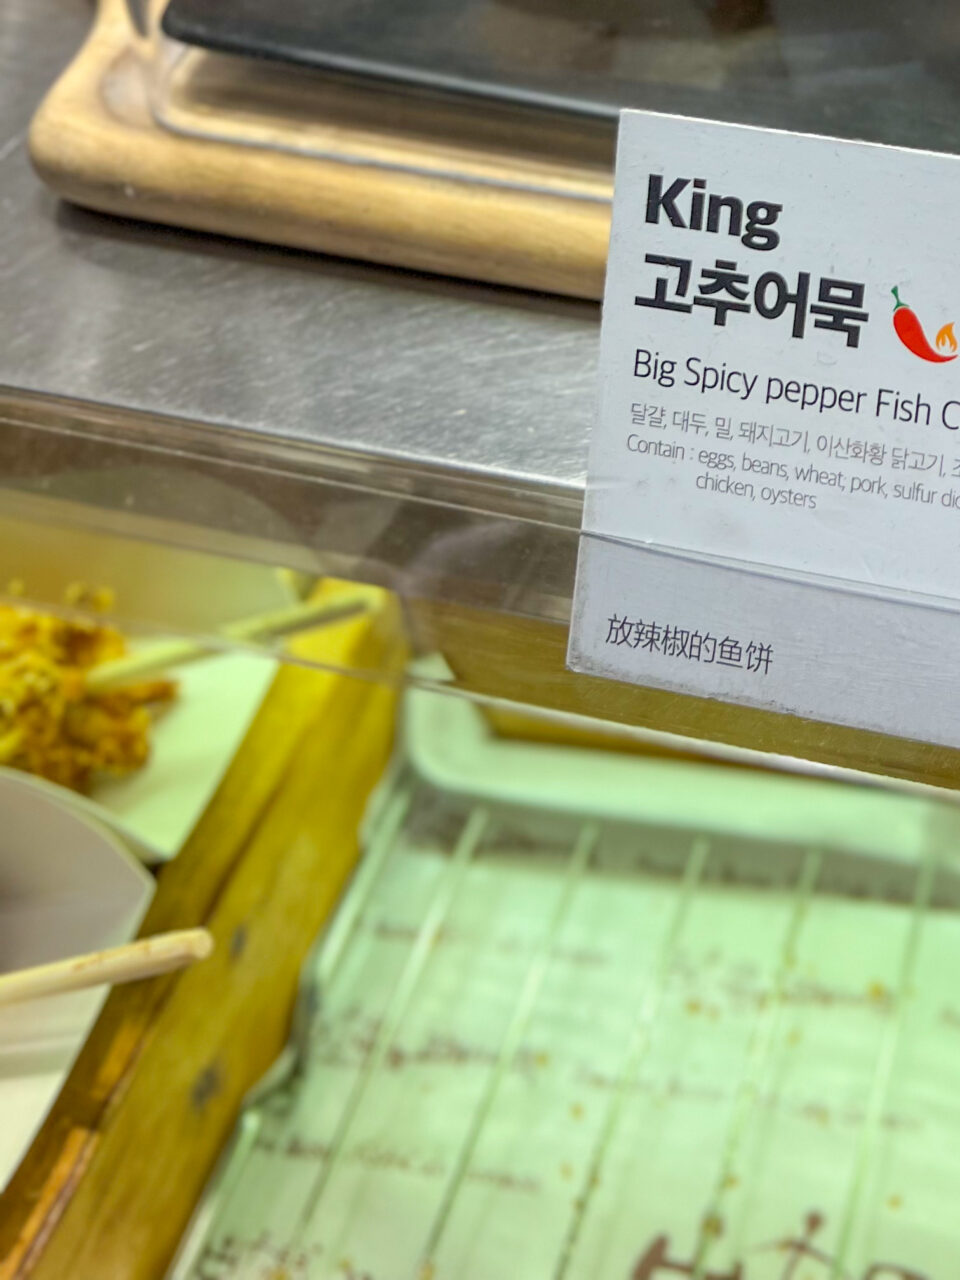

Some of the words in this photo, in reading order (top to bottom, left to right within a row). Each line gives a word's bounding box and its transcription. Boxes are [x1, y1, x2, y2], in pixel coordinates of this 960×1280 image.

[645, 173, 783, 251] King
[634, 252, 869, 349] 고추어묵
[633, 348, 677, 388] Big
[683, 357, 758, 401] Spicy
[765, 375, 868, 415] pepper
[875, 388, 931, 426] Fish
[626, 434, 685, 460] Contain
[698, 449, 736, 471] eggs,
[741, 452, 790, 482] beans,
[850, 473, 889, 499] pork,
[892, 481, 938, 505] sulfur
[631, 402, 667, 430] 달걀,
[672, 410, 708, 437] 대두,
[715, 417, 733, 441] 밀,
[738, 420, 811, 454] 돼지고기,
[816, 433, 888, 466] 이산화황
[891, 446, 946, 478] 닭고기,
[696, 472, 756, 502] chicken,
[760, 486, 817, 510] oysters
[605, 613, 774, 675] 放辣椒的鱼饼
